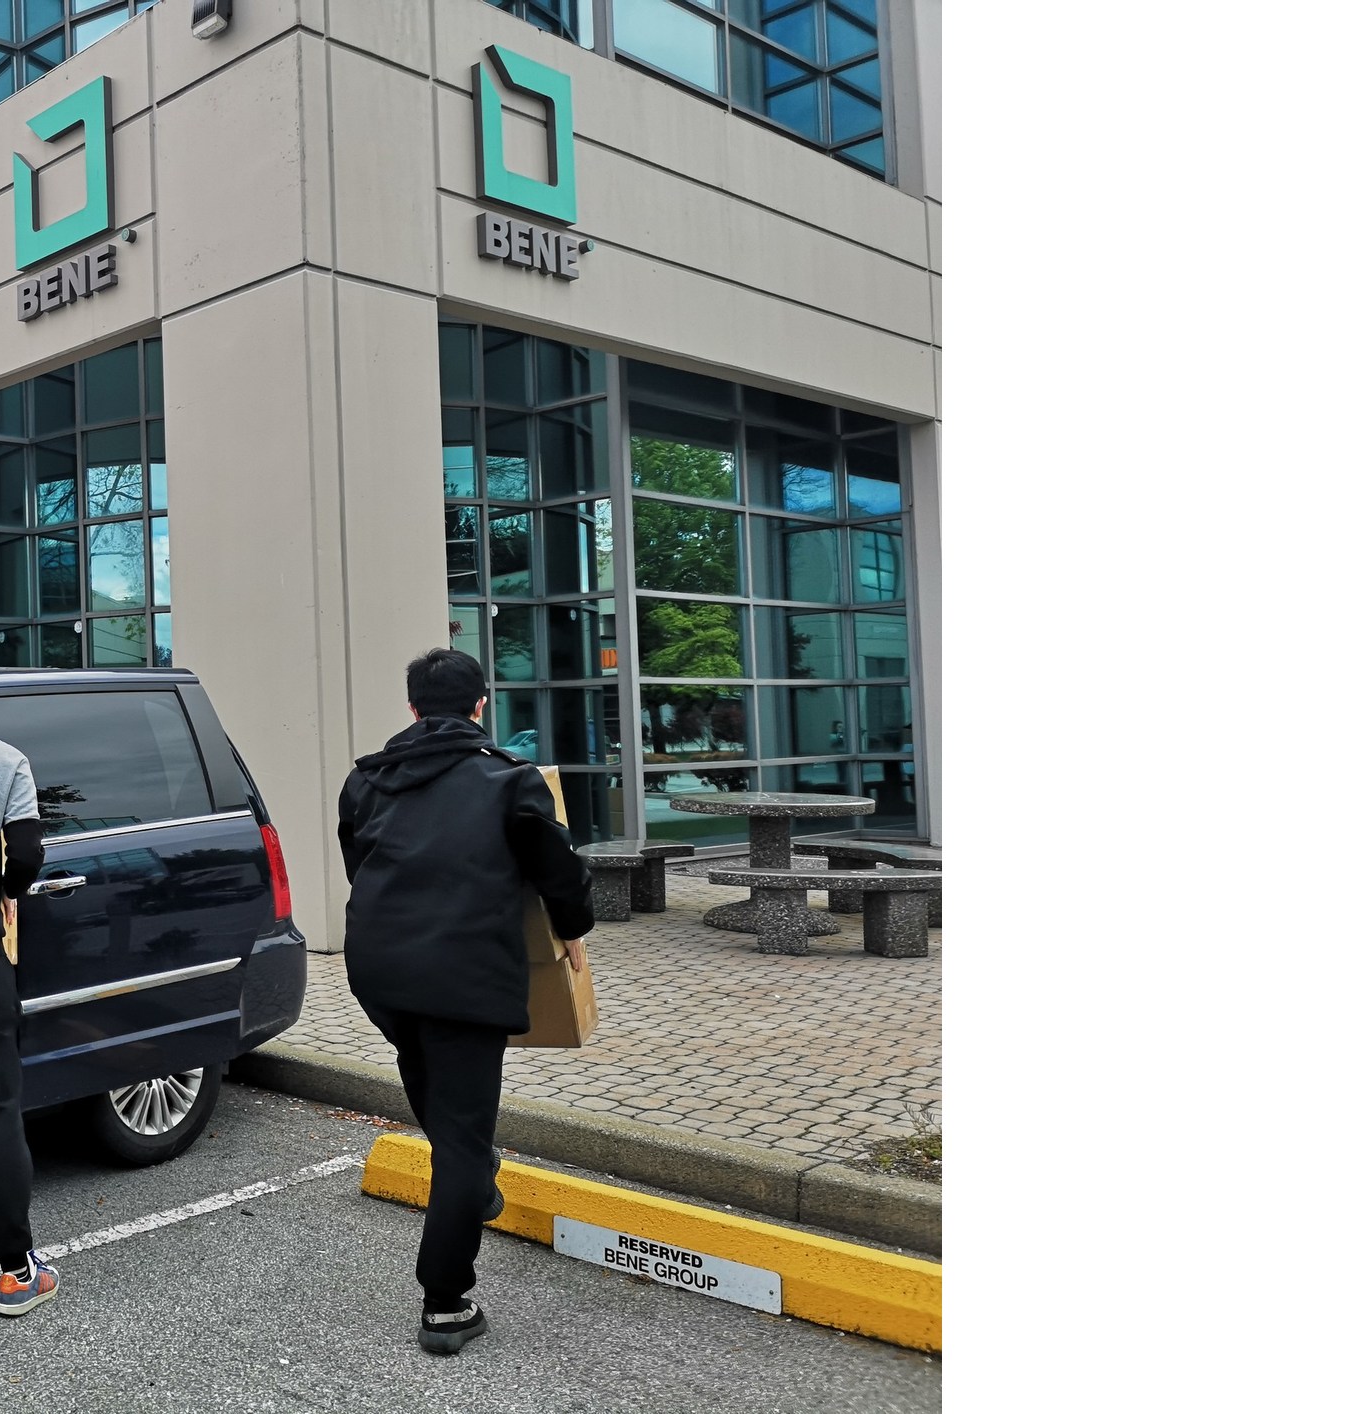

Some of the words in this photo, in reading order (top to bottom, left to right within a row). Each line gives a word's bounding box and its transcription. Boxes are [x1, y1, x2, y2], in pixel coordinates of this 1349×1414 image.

[476, 211, 580, 281] BENE
[16, 243, 119, 322] BENE
[604, 1247, 649, 1274] BENE
[654, 1261, 719, 1291] GROUP
[618, 1235, 703, 1269] RESERVED
